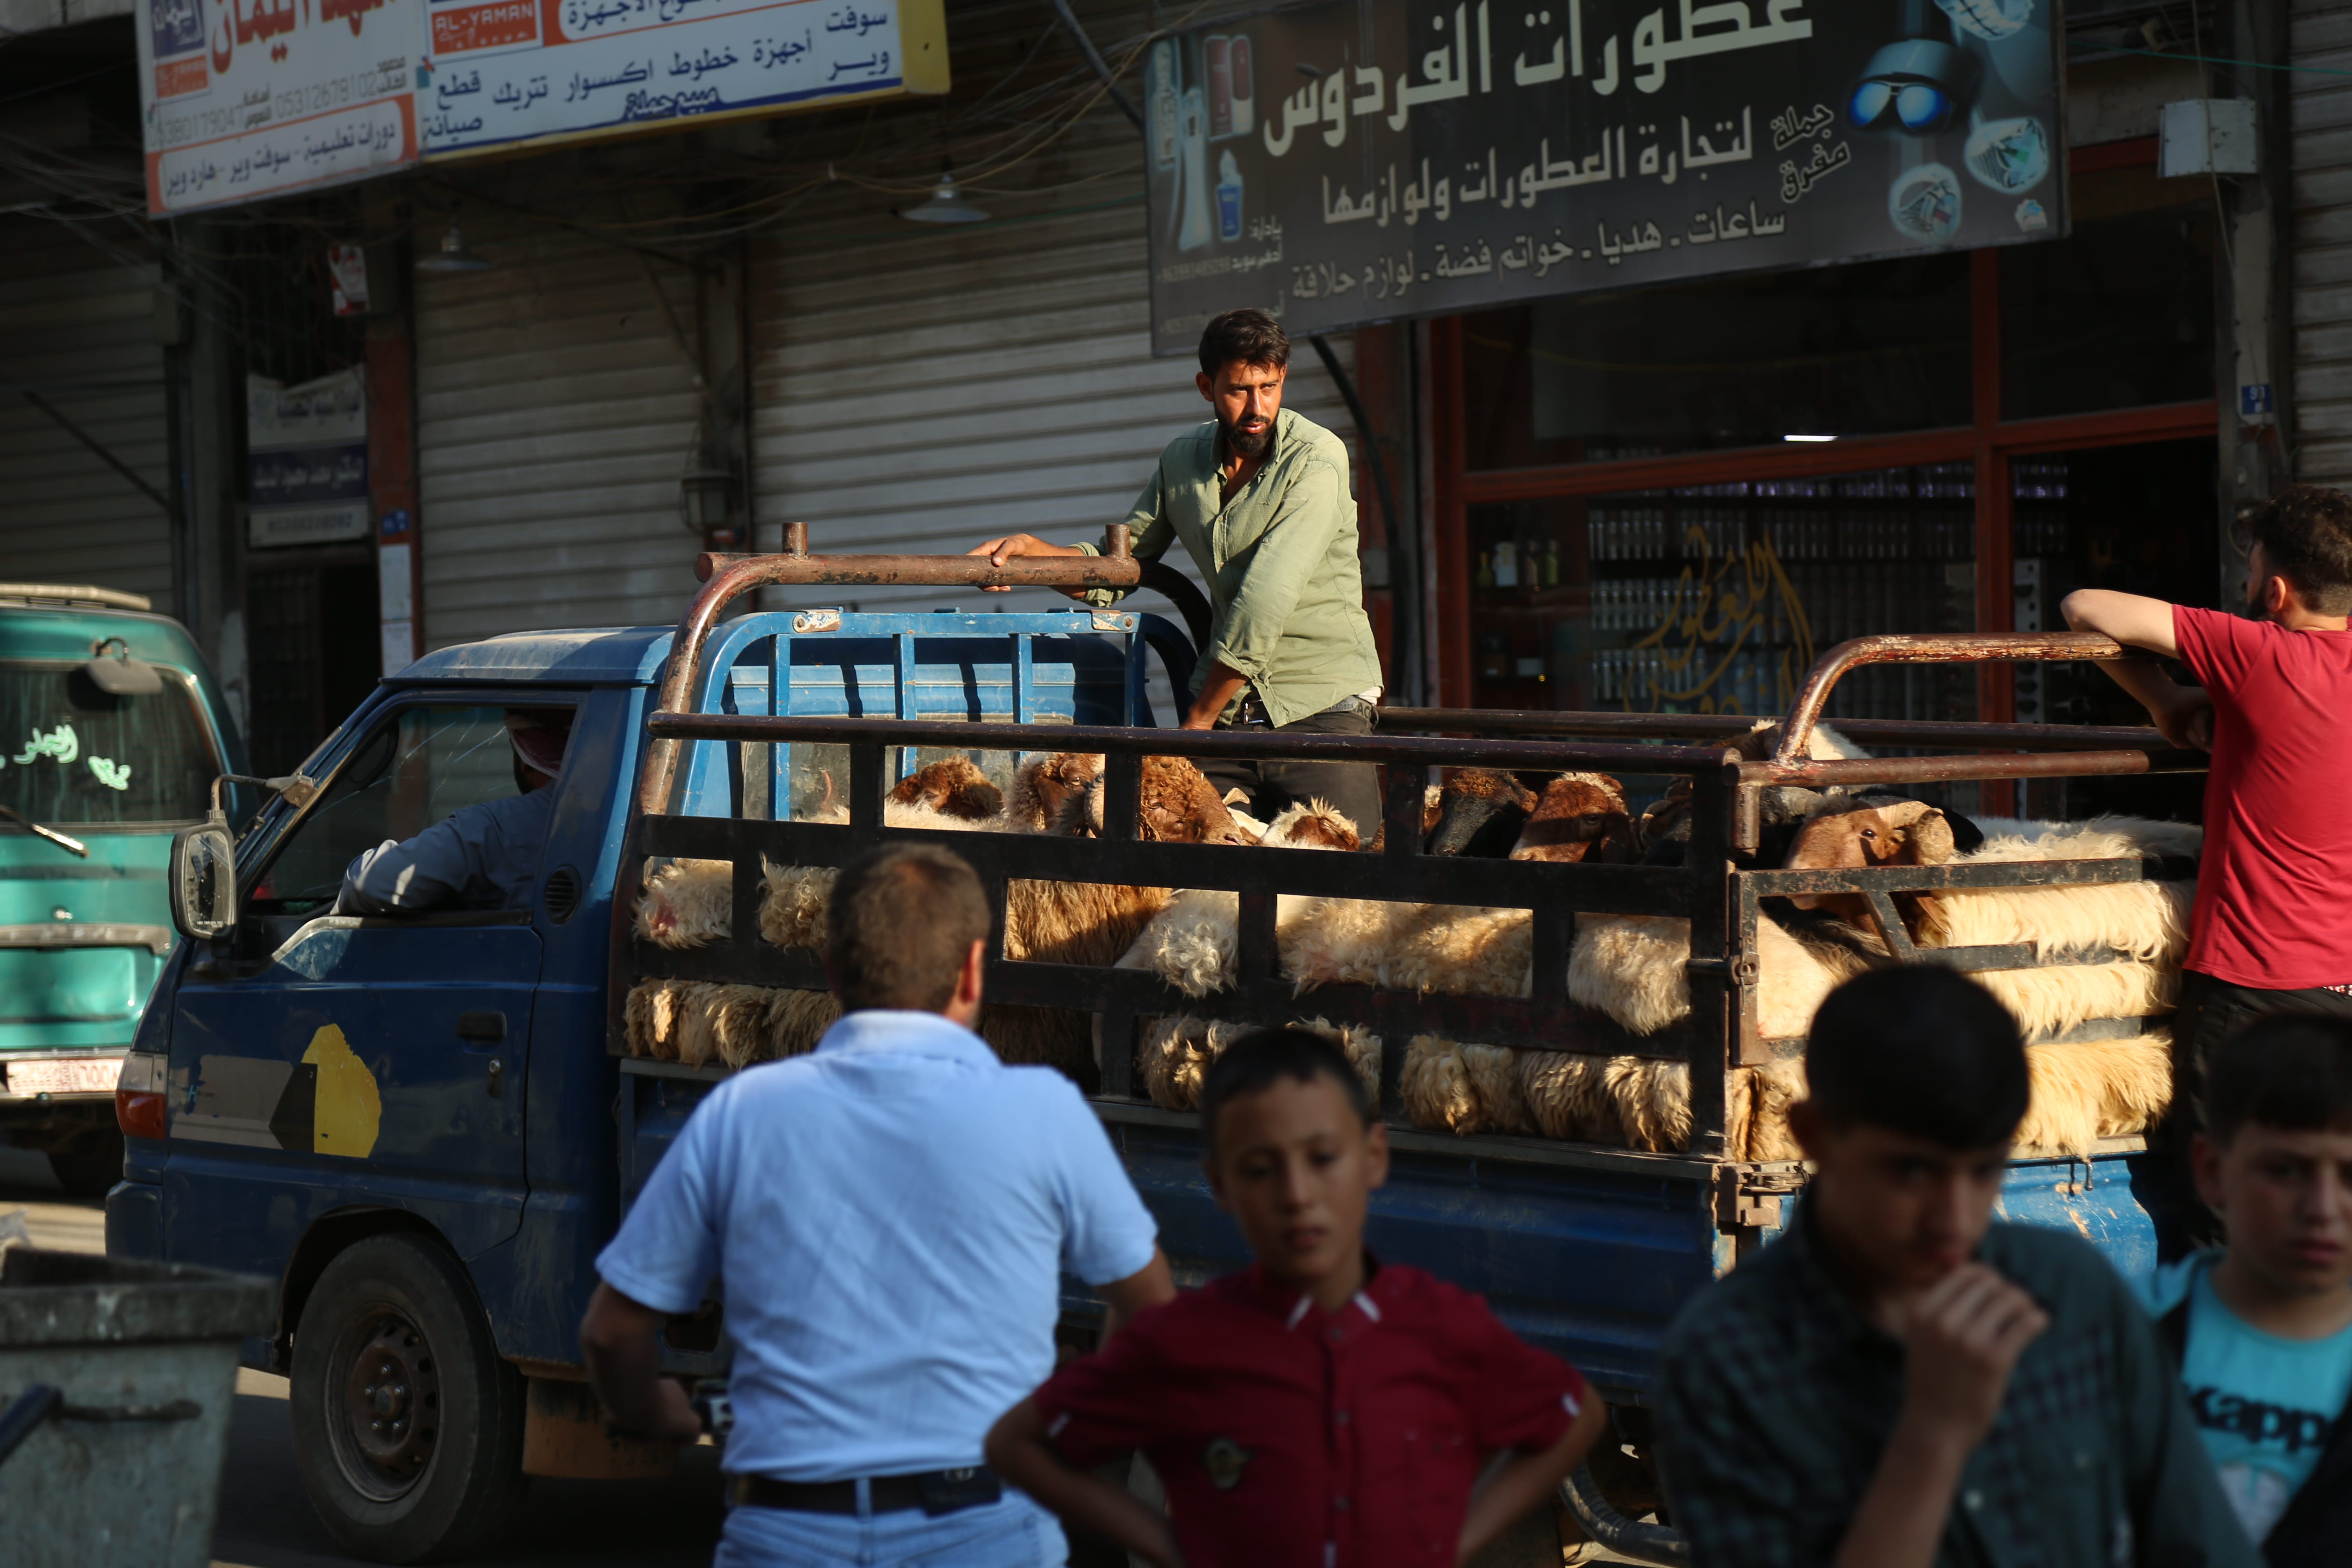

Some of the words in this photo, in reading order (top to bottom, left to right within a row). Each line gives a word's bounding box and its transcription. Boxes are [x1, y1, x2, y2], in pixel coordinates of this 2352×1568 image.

[435, 3, 534, 32] AL-YAMAN
[825, 5, 888, 36] سوفت
[668, 46, 739, 81] خطوط
[752, 27, 812, 69] أجهزة
[828, 49, 889, 81] وير
[1514, 0, 1813, 96] عطورات
[437, 69, 482, 111] قطع
[564, 59, 654, 102] اكسوار
[1263, 0, 1492, 157] الفردوس
[303, 125, 354, 163] تعليمية
[358, 121, 396, 154] دورات
[423, 114, 483, 143] صيانة
[1638, 104, 1753, 185] لتجارة
[1770, 104, 1834, 151] جملة
[190, 160, 215, 191] هارد
[229, 160, 249, 183] وير
[254, 143, 290, 173] سوفت
[1459, 125, 1626, 209] العطورات
[1780, 141, 1851, 204] مفرق
[166, 172, 187, 197] وير
[1323, 146, 1450, 227] ولوازمها
[1688, 199, 1786, 241] ساعات
[1362, 250, 1414, 301] لوازم
[1436, 238, 1492, 278] فضة
[1498, 227, 1574, 283] خواتم
[1291, 261, 1357, 300] حلاقة
